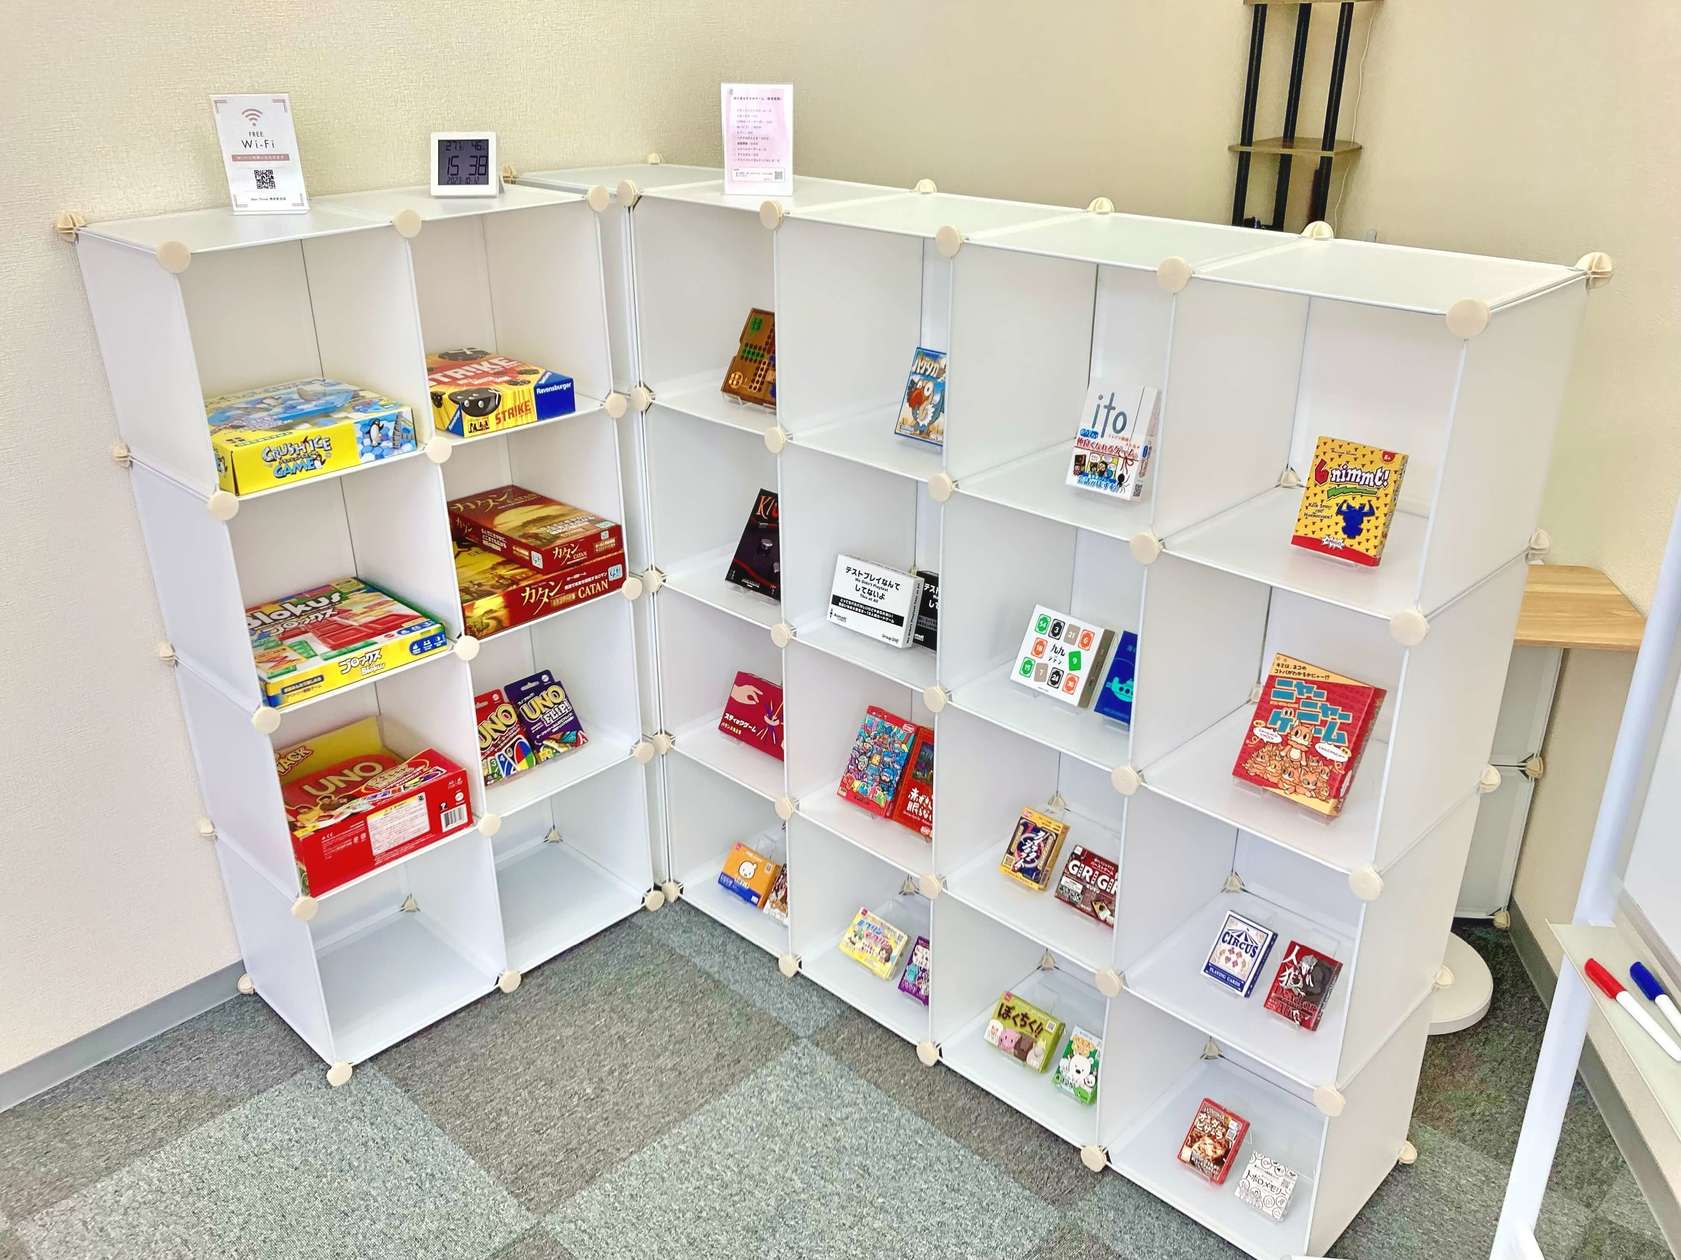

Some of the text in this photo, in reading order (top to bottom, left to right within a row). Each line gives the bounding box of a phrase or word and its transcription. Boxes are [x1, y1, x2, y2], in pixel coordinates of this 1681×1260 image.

[241, 139, 275, 149] Wi-Fi
[447, 155, 488, 176] 15 38
[536, 381, 572, 395] Ravensburger
[495, 400, 532, 425] STRIKE
[1091, 391, 1128, 439] ito
[262, 439, 306, 463] CRUSH
[308, 436, 333, 453] ICE
[273, 457, 317, 479] GAME
[1314, 458, 1391, 489] 6 nimmt!
[552, 543, 580, 567] カタン
[578, 579, 609, 599] CATAN
[844, 565, 901, 591] テストプレイなんて
[520, 579, 563, 616] カタン
[854, 584, 886, 601] してないよ
[264, 607, 339, 636] ブロックス
[338, 648, 383, 675] ブロックス
[519, 684, 566, 722] UNO
[1270, 677, 1327, 703] ニャー
[542, 699, 572, 726] FLIP!
[1296, 699, 1353, 725] ニャー
[478, 703, 519, 751] UNO
[1267, 708, 1349, 746] ゲーム
[302, 761, 384, 796] UNO
[1220, 930, 1259, 959] CIRCUS
